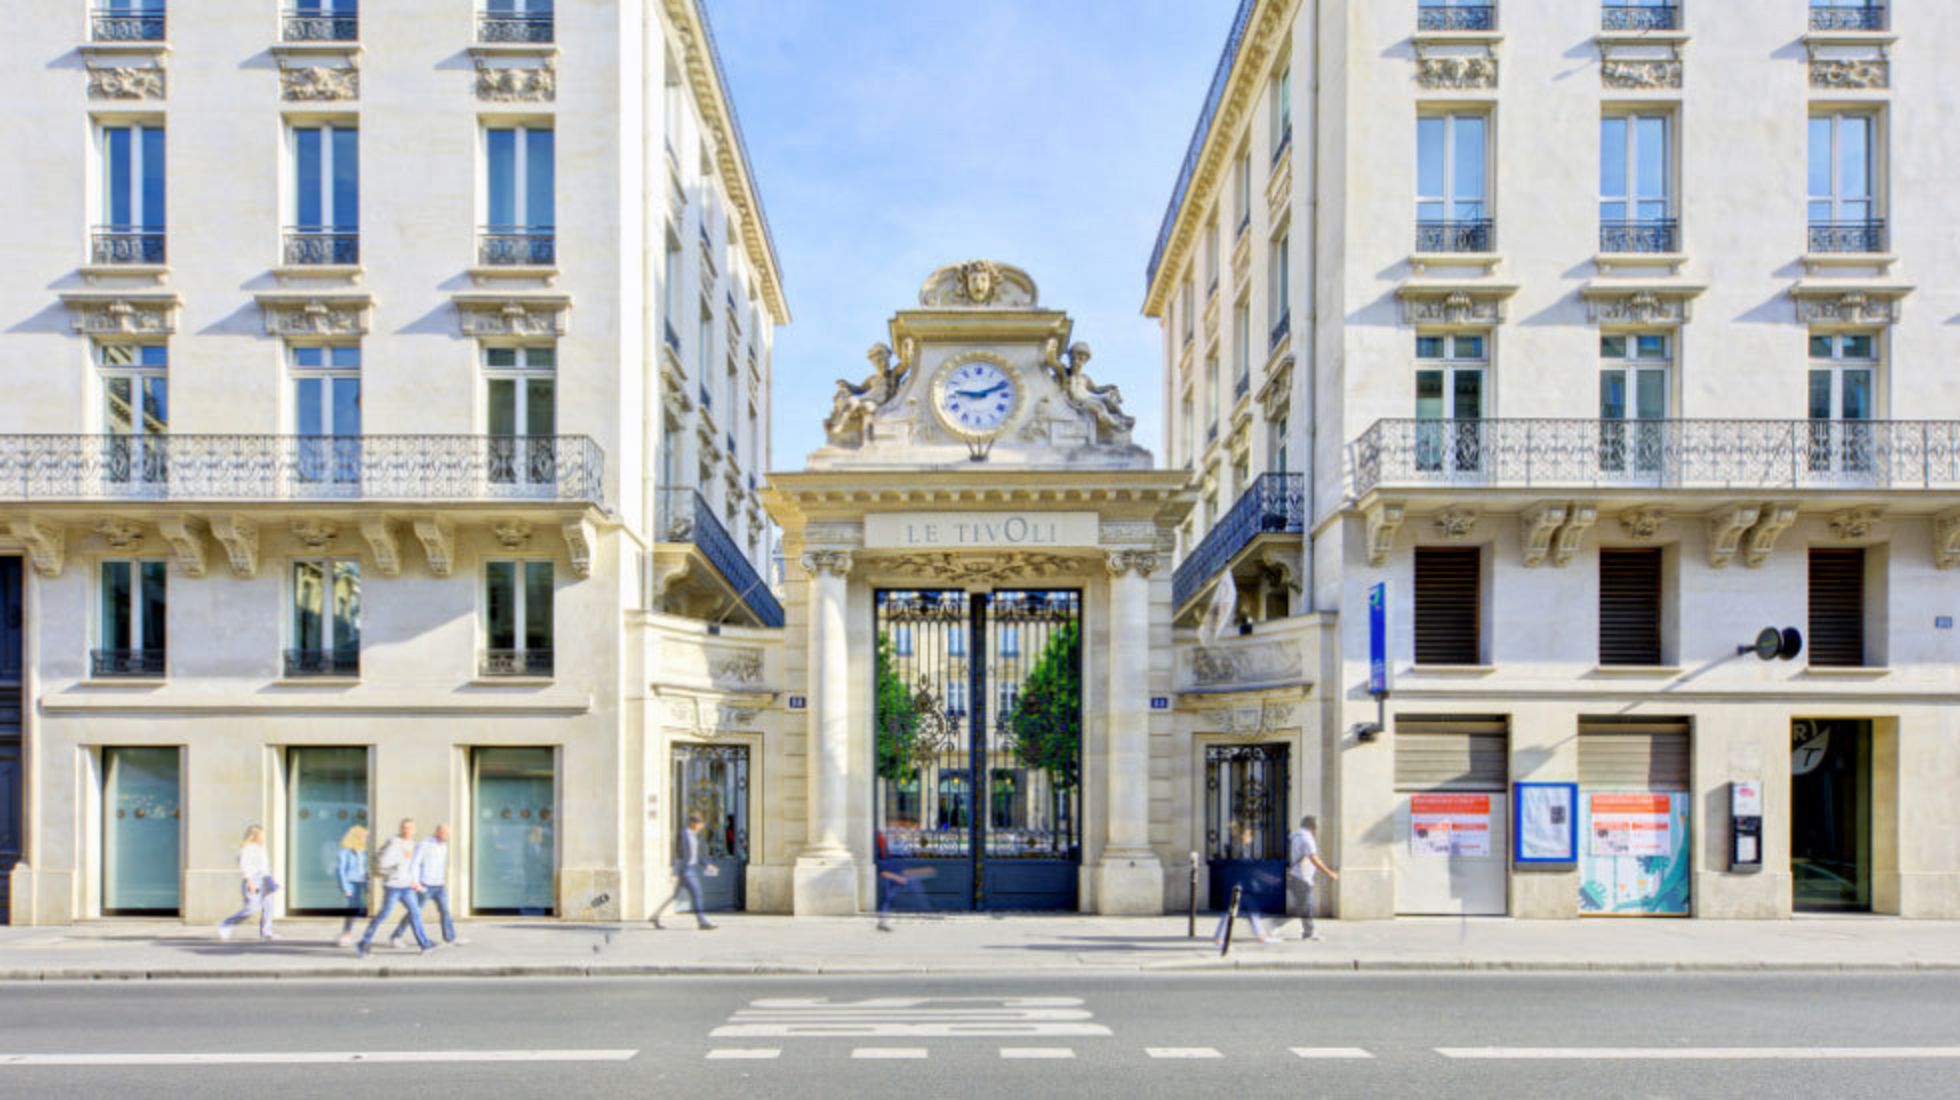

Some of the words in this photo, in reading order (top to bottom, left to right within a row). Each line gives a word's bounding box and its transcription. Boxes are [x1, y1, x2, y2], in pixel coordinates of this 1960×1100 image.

[907, 523, 939, 543] LE
[953, 516, 1057, 543] TIVOLI
[708, 995, 1114, 1038] BUS
